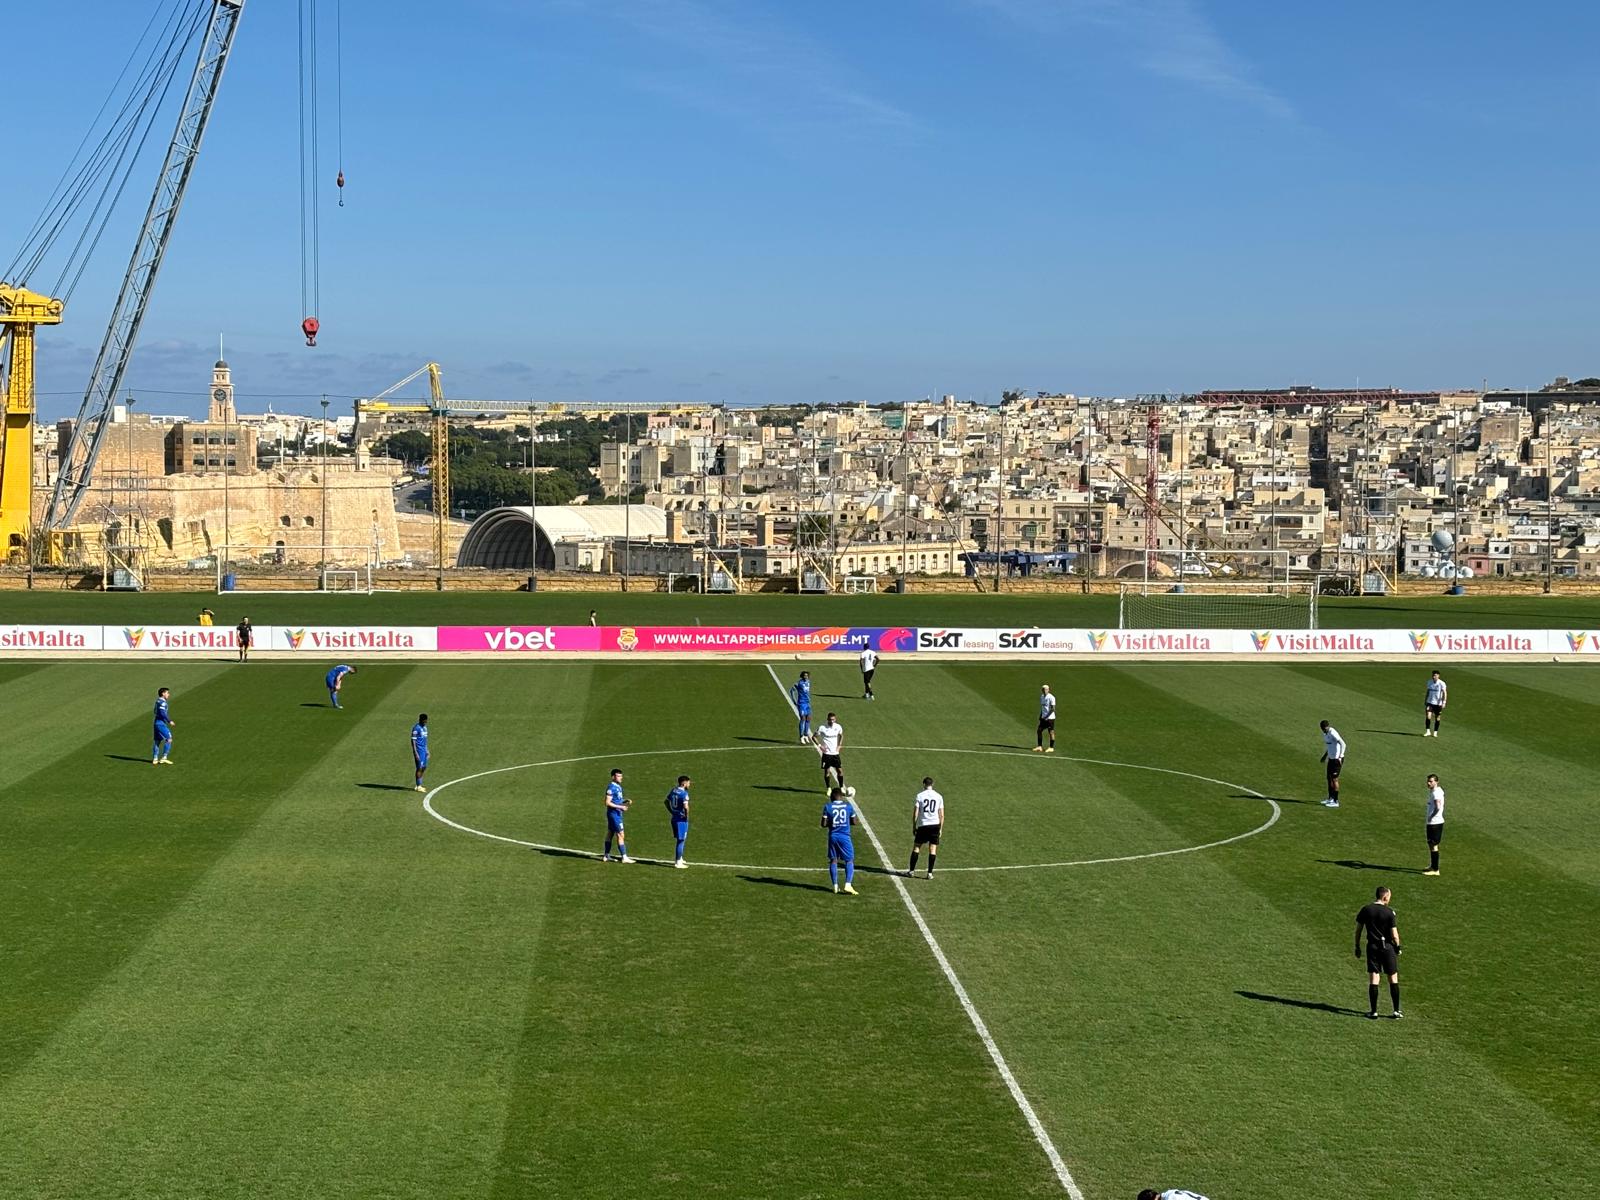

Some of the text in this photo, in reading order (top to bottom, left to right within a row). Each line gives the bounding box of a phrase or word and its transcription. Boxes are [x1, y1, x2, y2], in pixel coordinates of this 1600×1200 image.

[0, 629, 85, 647] sitMalta
[311, 631, 414, 648] VisitMalta
[484, 627, 556, 650] vbet
[653, 633, 870, 645] WWW.MALTAPREMIERLEAGUE.MT
[963, 640, 995, 650] leasing
[1042, 641, 1073, 650] leasing
[1113, 633, 1211, 650] VisitMalta
[1275, 634, 1375, 650] VisitMalta
[1433, 634, 1532, 651] VisitMalta
[923, 799, 937, 813] 20
[832, 809, 847, 824] 29
